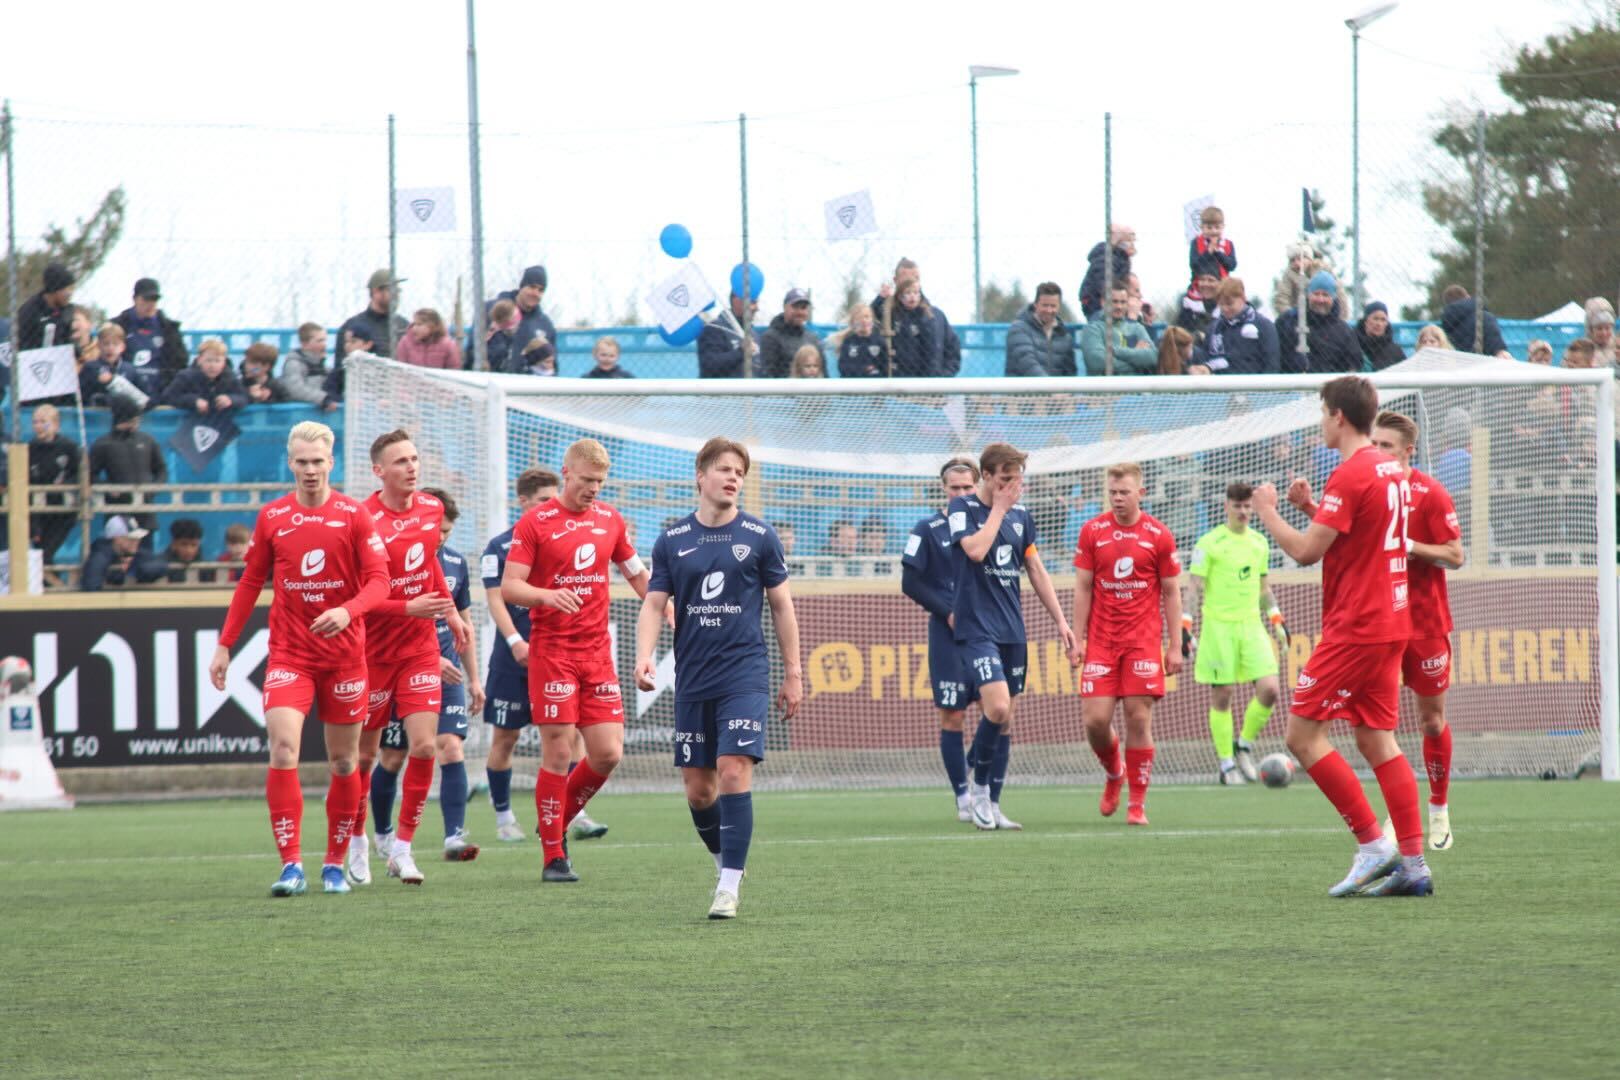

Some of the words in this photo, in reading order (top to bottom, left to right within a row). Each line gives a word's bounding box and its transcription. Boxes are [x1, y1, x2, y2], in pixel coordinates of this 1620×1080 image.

[740, 520, 767, 536] NOBI
[283, 578, 345, 591] Sparebanken
[302, 592, 326, 602] Vest
[686, 602, 742, 616] Sparebanken
[700, 615, 722, 627] Vest
[978, 664, 993, 681] 13
[941, 689, 958, 706] 28
[496, 709, 507, 726] 11
[544, 704, 558, 718] 19
[727, 719, 751, 730] SPZ
[385, 729, 402, 745] 24
[675, 732, 693, 743] SPZ
[72, 735, 99, 757] 50
[128, 734, 270, 754] www.unikvvs.
[682, 743, 692, 763] 9
